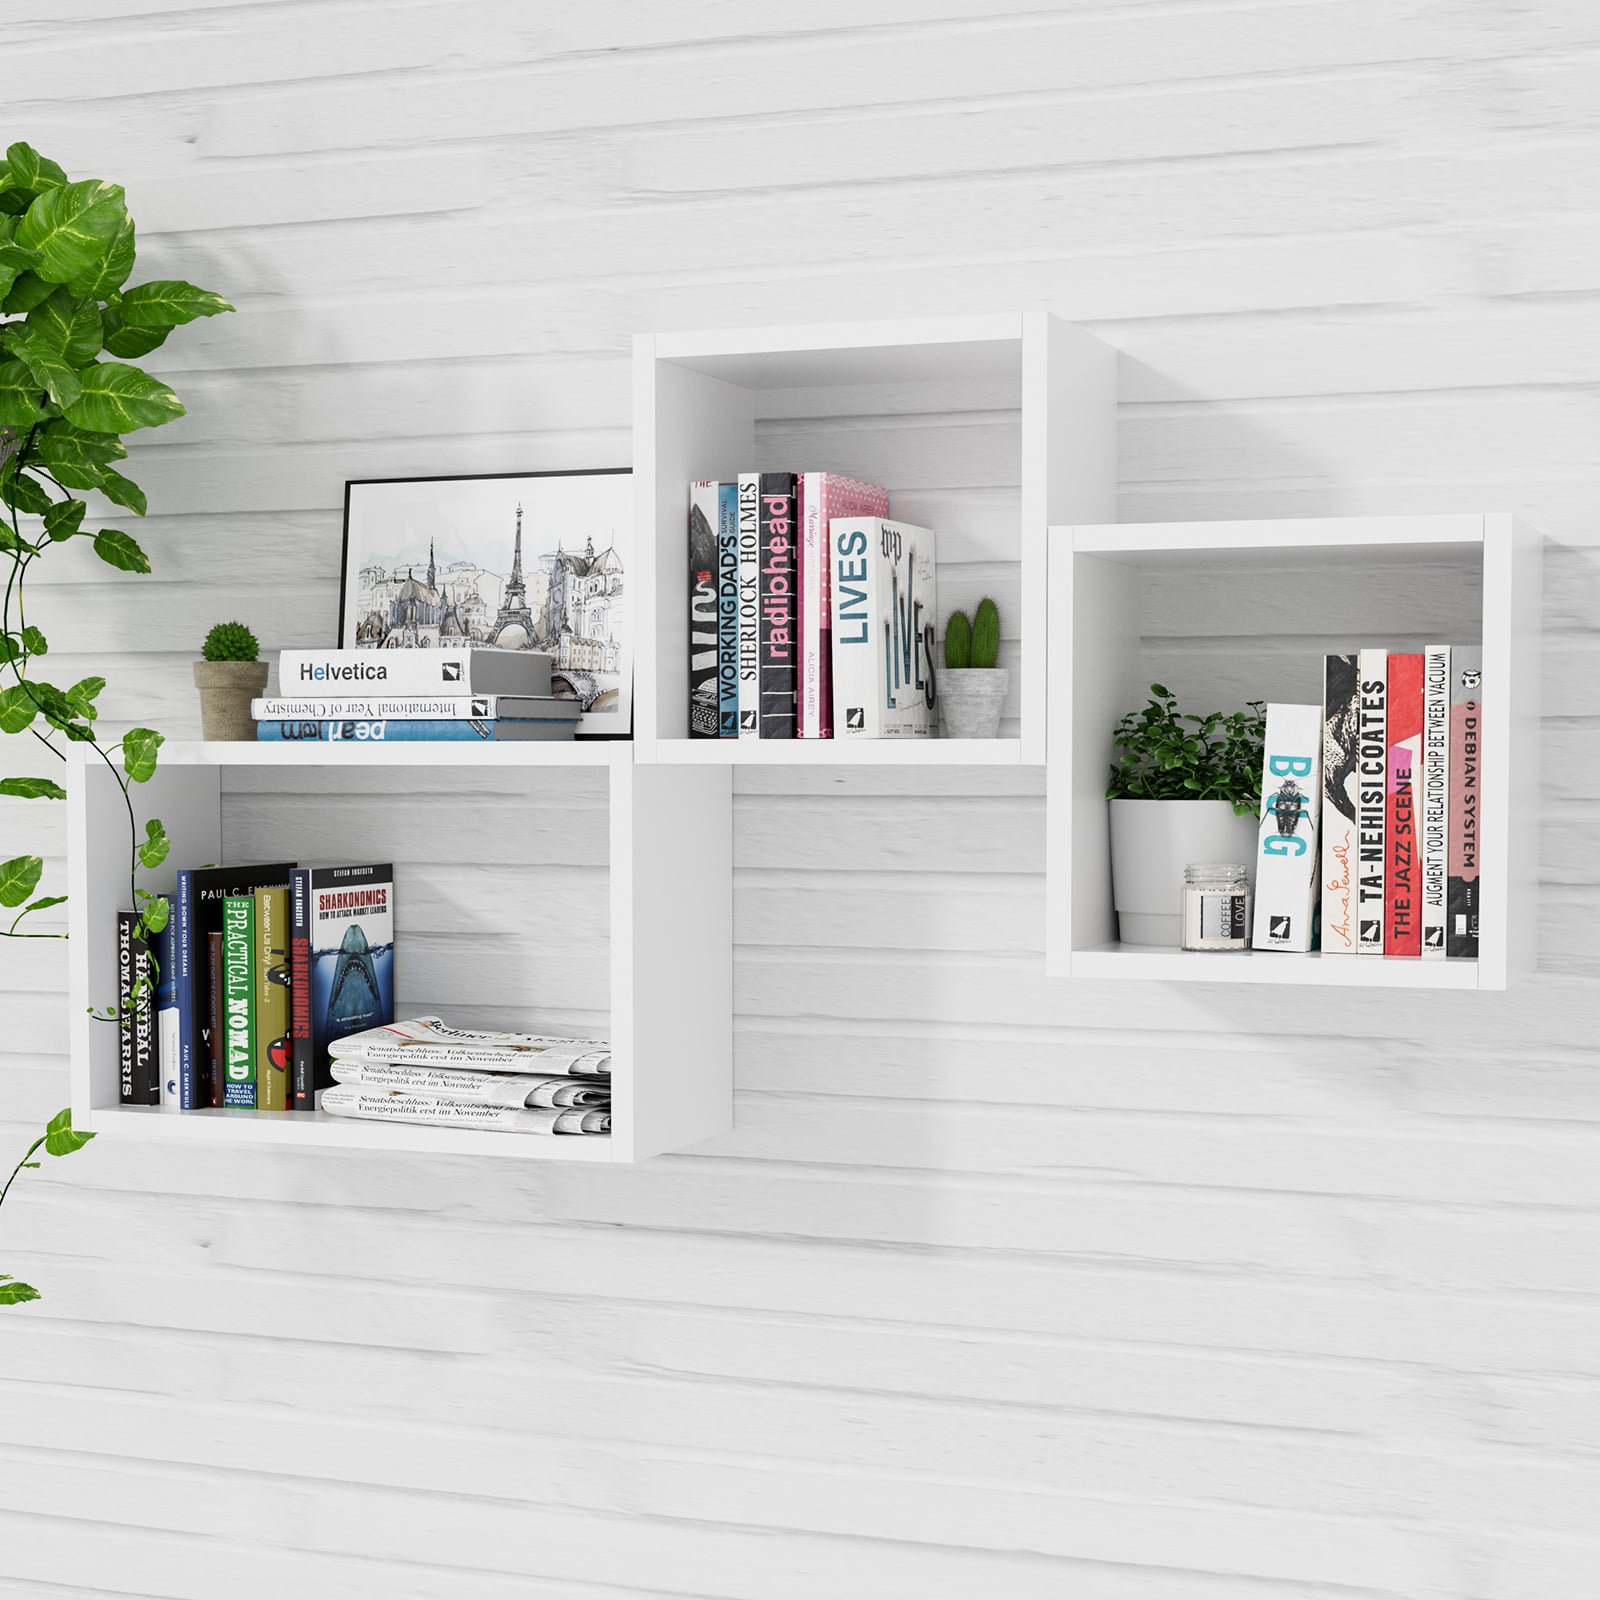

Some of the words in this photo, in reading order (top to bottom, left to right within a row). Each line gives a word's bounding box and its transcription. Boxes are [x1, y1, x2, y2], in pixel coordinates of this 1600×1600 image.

[740, 482, 757, 564] HOLMES
[806, 505, 818, 548] Marriage
[721, 536, 737, 597] DAD'S
[763, 497, 788, 659] radiohead
[838, 530, 869, 644] LIVES
[721, 599, 737, 701] WORKING
[740, 576, 757, 680] SHERLOCK
[884, 551, 937, 711] LIVES
[300, 663, 387, 680] Helvetica
[807, 652, 815, 683] ALICIA
[1429, 653, 1446, 696] VACUUM
[264, 701, 326, 717] Chemistry
[328, 703, 342, 717] of
[345, 703, 373, 717] Year
[378, 703, 456, 717] International
[807, 687, 815, 716] AIREY
[1428, 697, 1445, 748] BETWEEN
[328, 720, 386, 741] pearl
[1361, 681, 1385, 775] COATES
[1464, 717, 1477, 787] DEBIAN
[1264, 755, 1312, 857] BUG
[1395, 768, 1412, 835] SCENE
[1428, 751, 1444, 824] RELATIONSHIP
[1360, 782, 1384, 903] TA-NEHISI
[1427, 826, 1443, 857] YOUR
[1463, 794, 1476, 867] SYSTEM
[295, 876, 303, 897] STEFAN
[1394, 841, 1411, 894] JAZZ
[1427, 857, 1443, 906] AUGMENT
[201, 889, 228, 900] PAUL
[262, 895, 271, 932] Between
[319, 889, 387, 911] SHARKONOMICS
[1235, 898, 1245, 927] LOVE
[1220, 899, 1231, 937] COFFEE
[1330, 897, 1352, 947] Anna
[1394, 899, 1410, 939] THE
[228, 909, 248, 994] PRACTICAL
[292, 937, 310, 1039] SHARKONOMICS
[228, 998, 250, 1080] NOMAD
[367, 1051, 428, 1062] Energiepolitik
[464, 1055, 513, 1063] November
[360, 1074, 410, 1086] Energiepolitik
[440, 1081, 482, 1090] November
[359, 1104, 417, 1115] Energiepolitik
[454, 1109, 501, 1118] November
